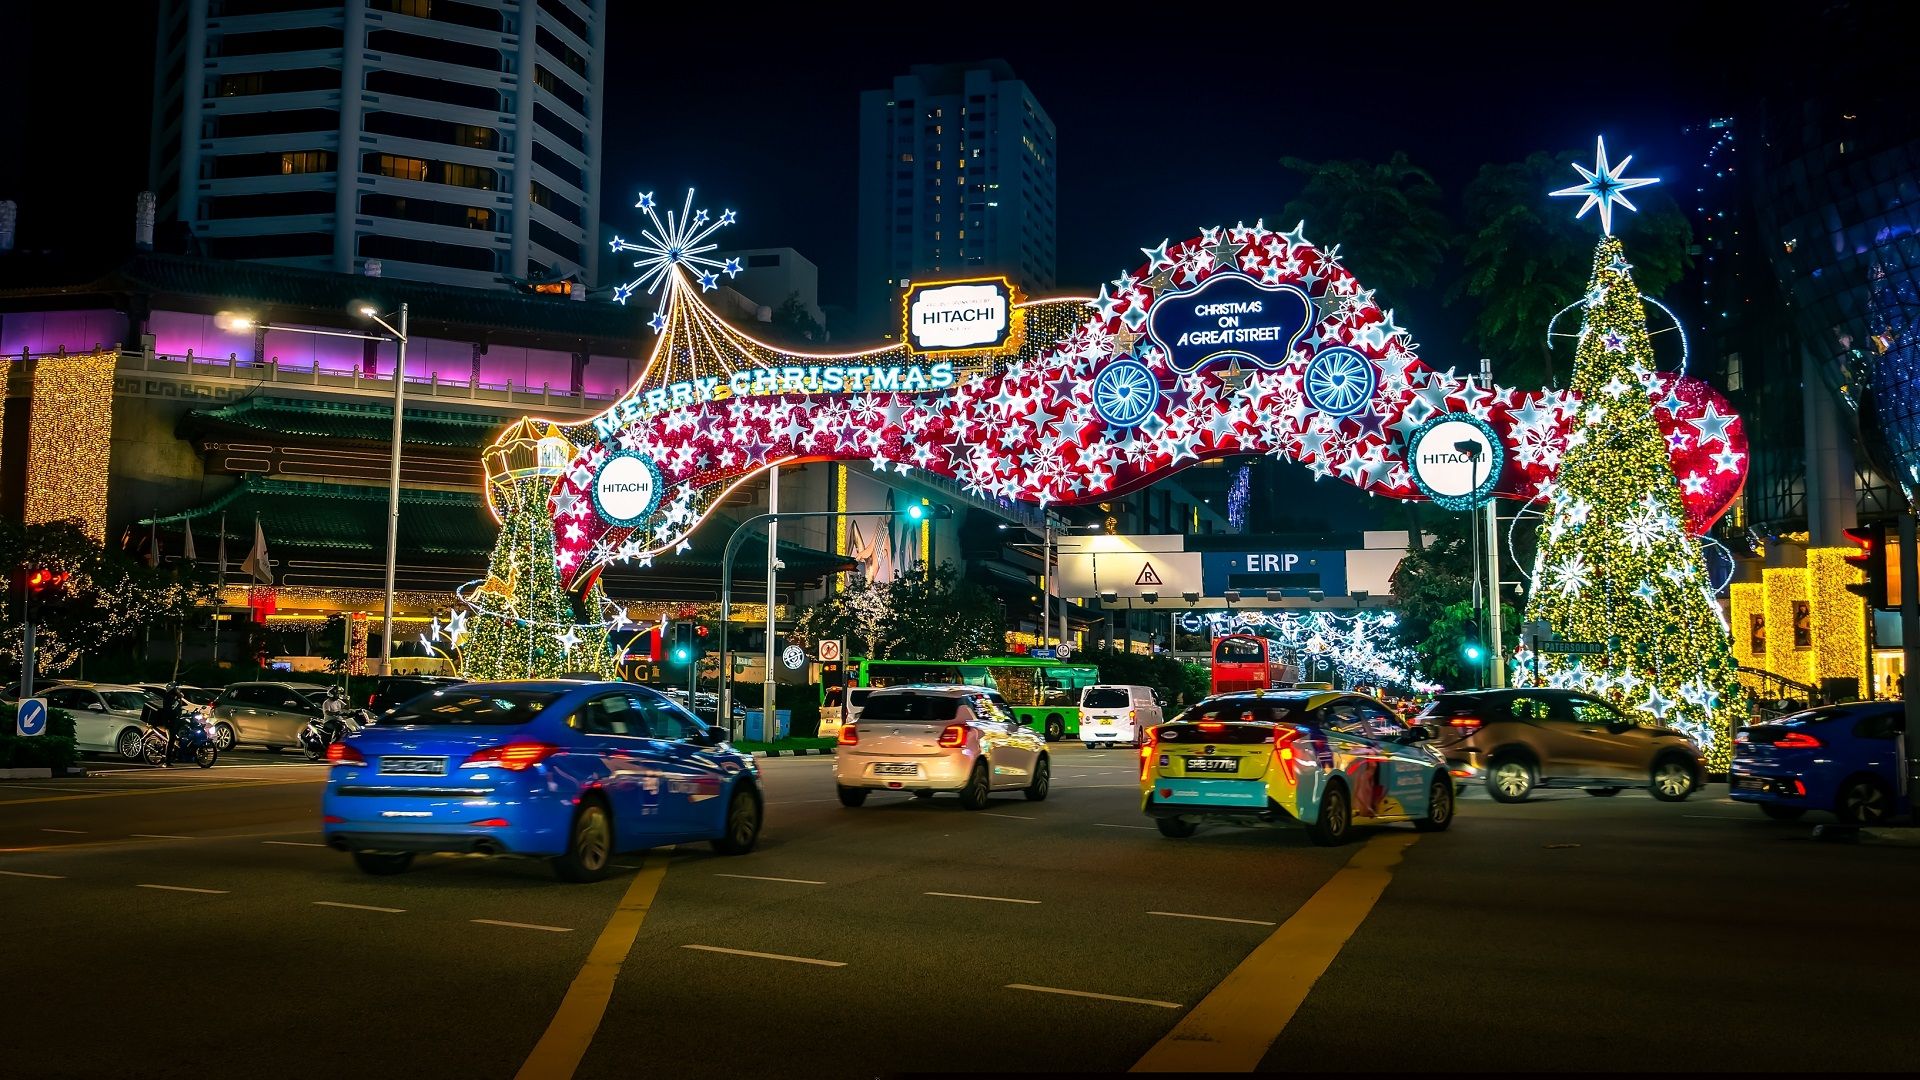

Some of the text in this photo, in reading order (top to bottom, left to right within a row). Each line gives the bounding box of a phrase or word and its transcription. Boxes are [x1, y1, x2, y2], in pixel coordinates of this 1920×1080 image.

[1194, 301, 1263, 316] CHRISTMAS
[923, 307, 994, 325] HITACHI
[1218, 316, 1239, 328] ON
[1176, 326, 1281, 347] A GREAT STREET
[593, 361, 956, 439] MERRY CHRISTMAS
[603, 483, 648, 493] HITACHI
[1144, 571, 1153, 582] R
[1544, 642, 1601, 652] PATERSON RD
